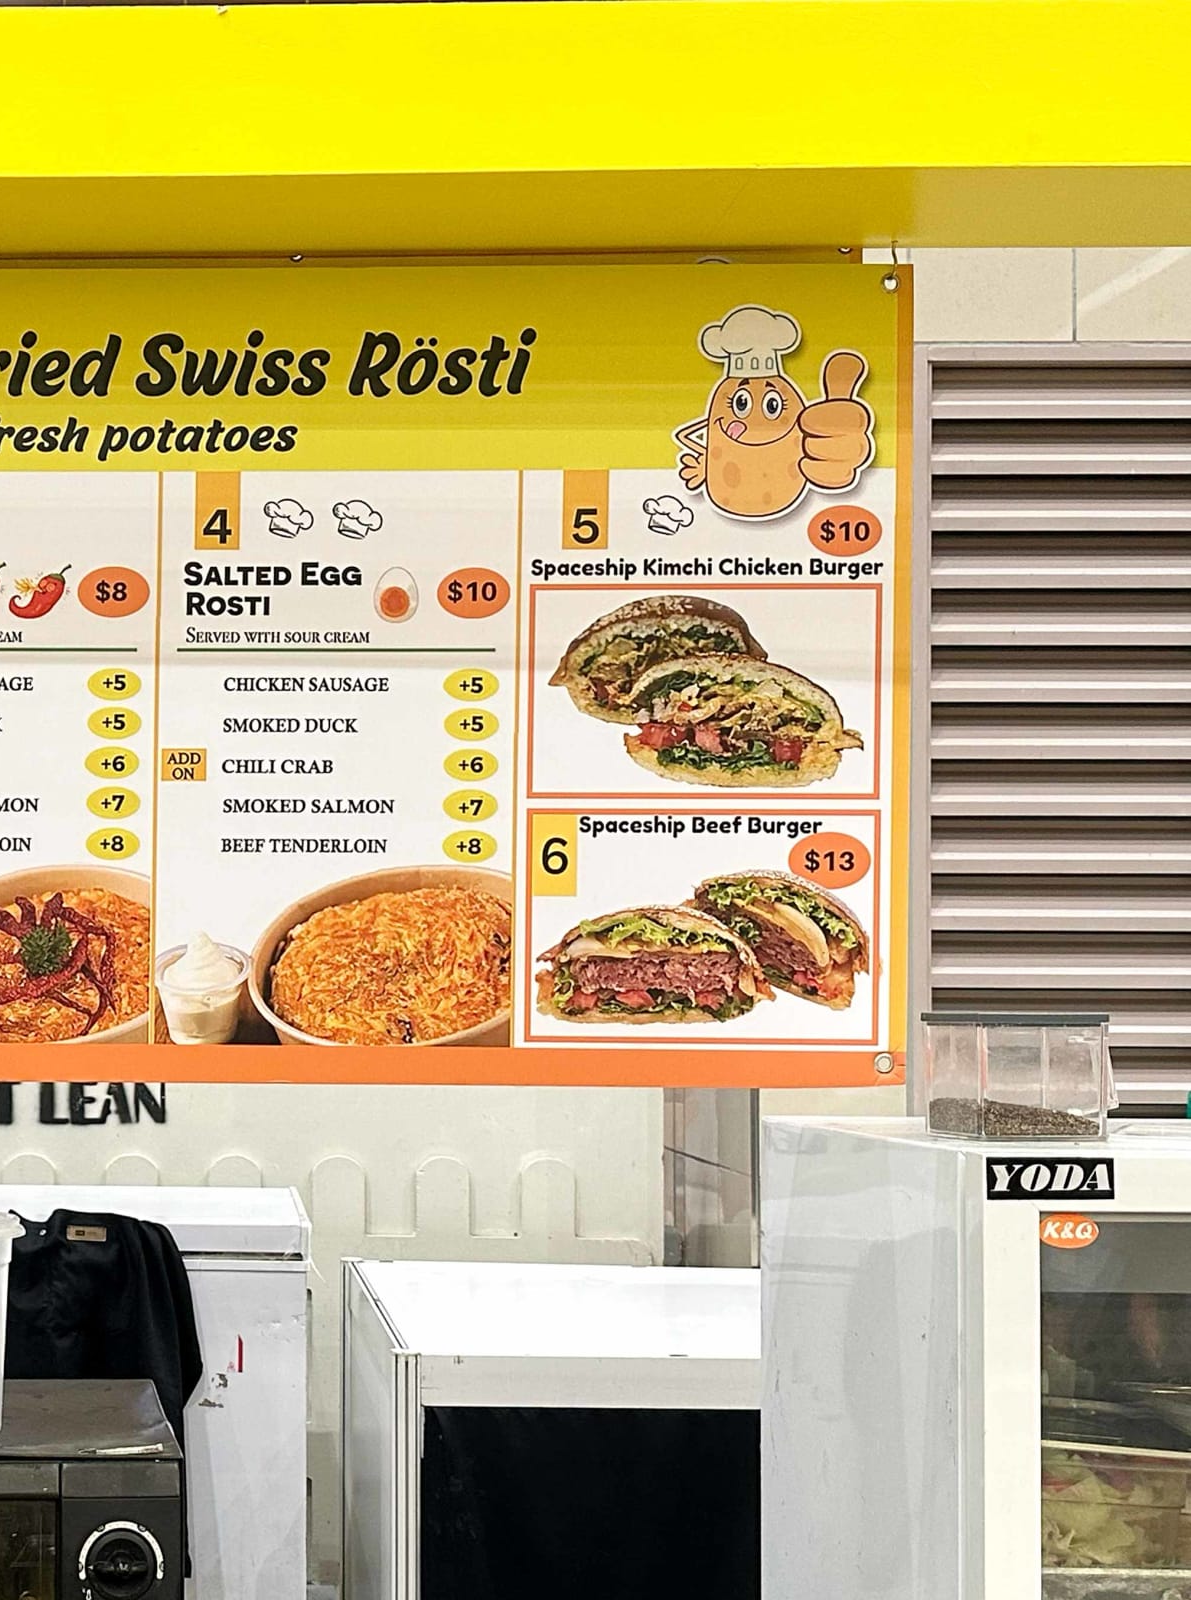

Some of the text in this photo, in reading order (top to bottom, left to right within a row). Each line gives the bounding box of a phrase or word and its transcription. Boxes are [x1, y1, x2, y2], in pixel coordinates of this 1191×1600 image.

[136, 330, 330, 396] Swiss
[349, 328, 537, 396] Rösti
[98, 419, 297, 461] potatoes
[203, 510, 231, 544] 4
[573, 509, 599, 544] 5
[820, 520, 870, 544] $10
[184, 562, 361, 586] SALTED EGG
[532, 558, 883, 581] Spaceship Kimchi Chicken Burger
[95, 581, 127, 603] $8
[448, 580, 497, 603] $10
[187, 592, 269, 616] ROSTI
[102, 674, 127, 691] +5
[224, 678, 389, 691] CHICKEN SAUSAGE
[459, 677, 483, 693] +5
[102, 714, 126, 730] +5
[224, 719, 357, 732] SMOKED DUCK
[460, 715, 484, 732] +5
[101, 755, 125, 772] +6
[167, 753, 201, 764] ADD
[222, 760, 333, 773] CHILI CRAB
[458, 757, 483, 773] +6
[173, 768, 195, 780] ON
[101, 795, 125, 811] +7
[223, 799, 394, 813] SMOKED SALMON
[458, 798, 483, 816] +7
[580, 816, 822, 838] Spaceship Beef Burger
[100, 835, 124, 851] +8
[222, 839, 387, 853] BEEF TENDERLOIN
[456, 838, 481, 854] +8
[543, 838, 568, 874] 6
[804, 849, 855, 872] $13
[38, 1081, 166, 1125] LEAN
[990, 1164, 1112, 1192] YODA
[1043, 1221, 1093, 1240] K&Q
